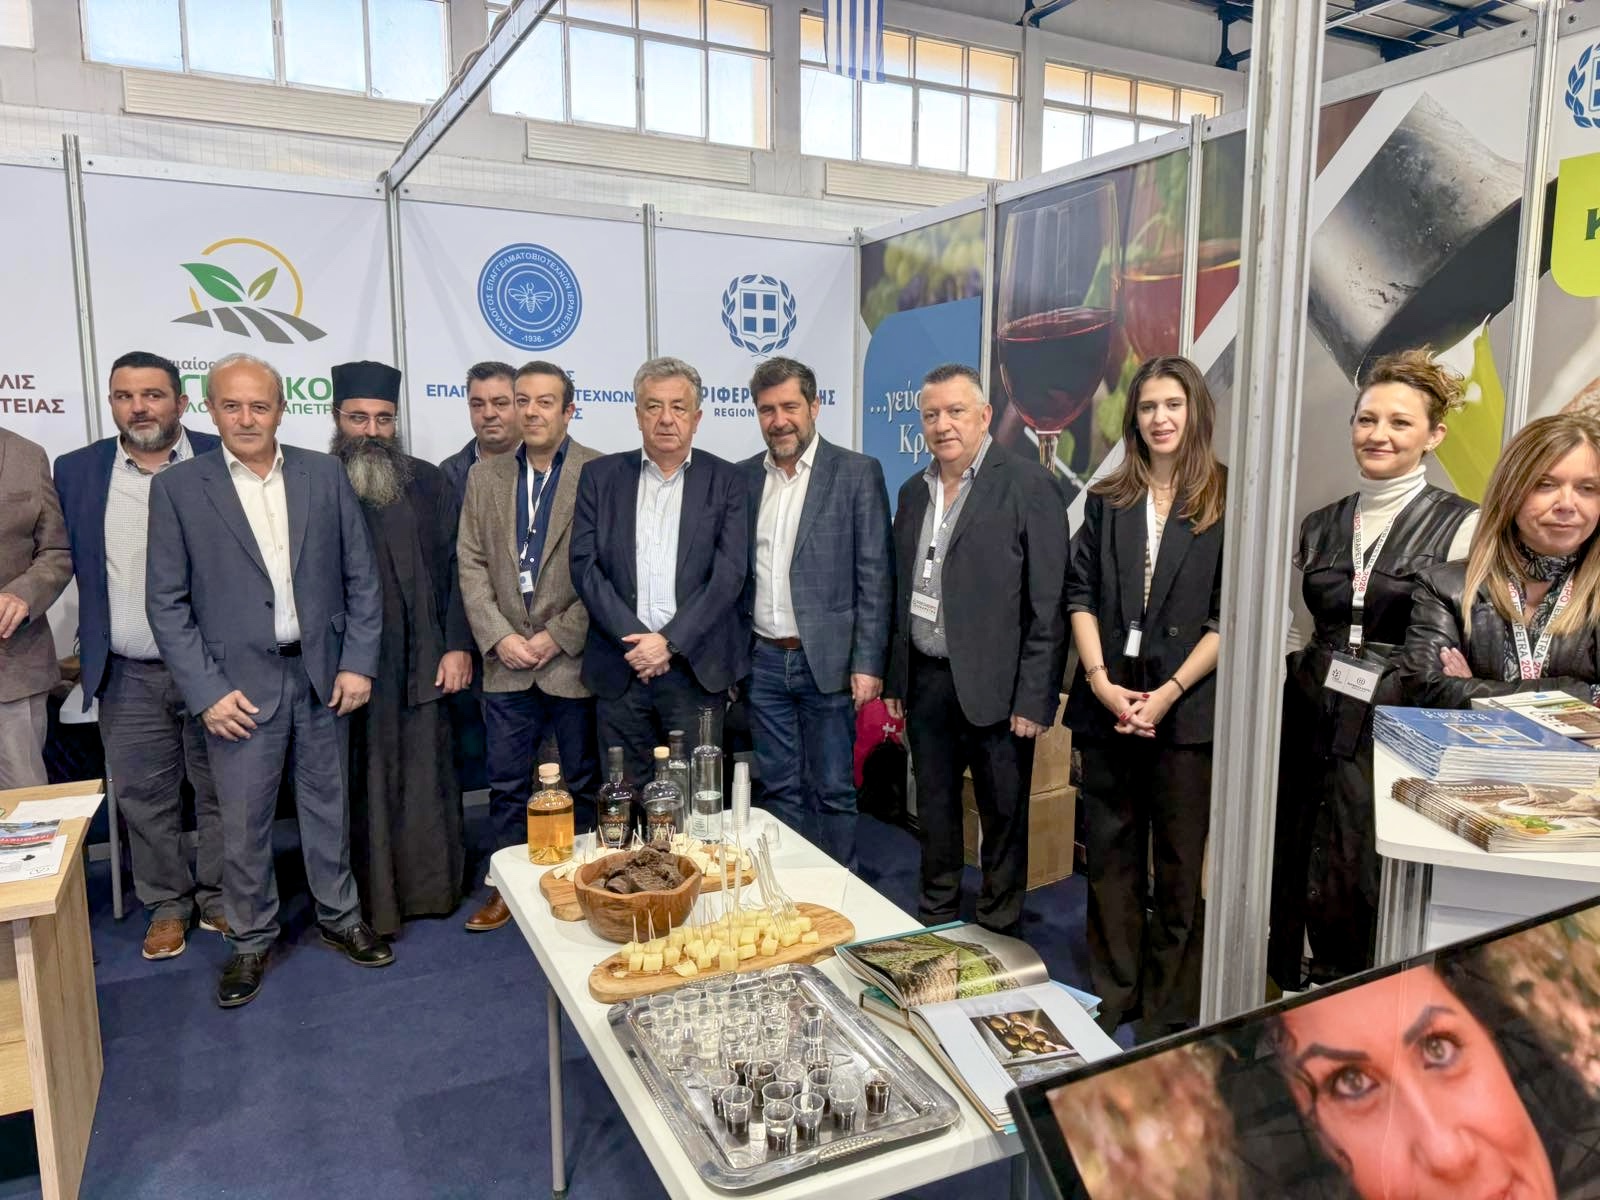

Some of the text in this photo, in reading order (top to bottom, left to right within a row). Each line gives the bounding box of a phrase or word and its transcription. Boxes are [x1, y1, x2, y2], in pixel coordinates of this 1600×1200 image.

[486, 294, 514, 335] ΣΥΛΛΟΓΟΣ
[551, 291, 575, 337] ΙΕΡΑΠΕΤΡΑΣ
[0, 374, 36, 389] ΛΙΣ
[0, 398, 65, 414] ΤΕΙΑΣ
[714, 408, 755, 417] REGION
